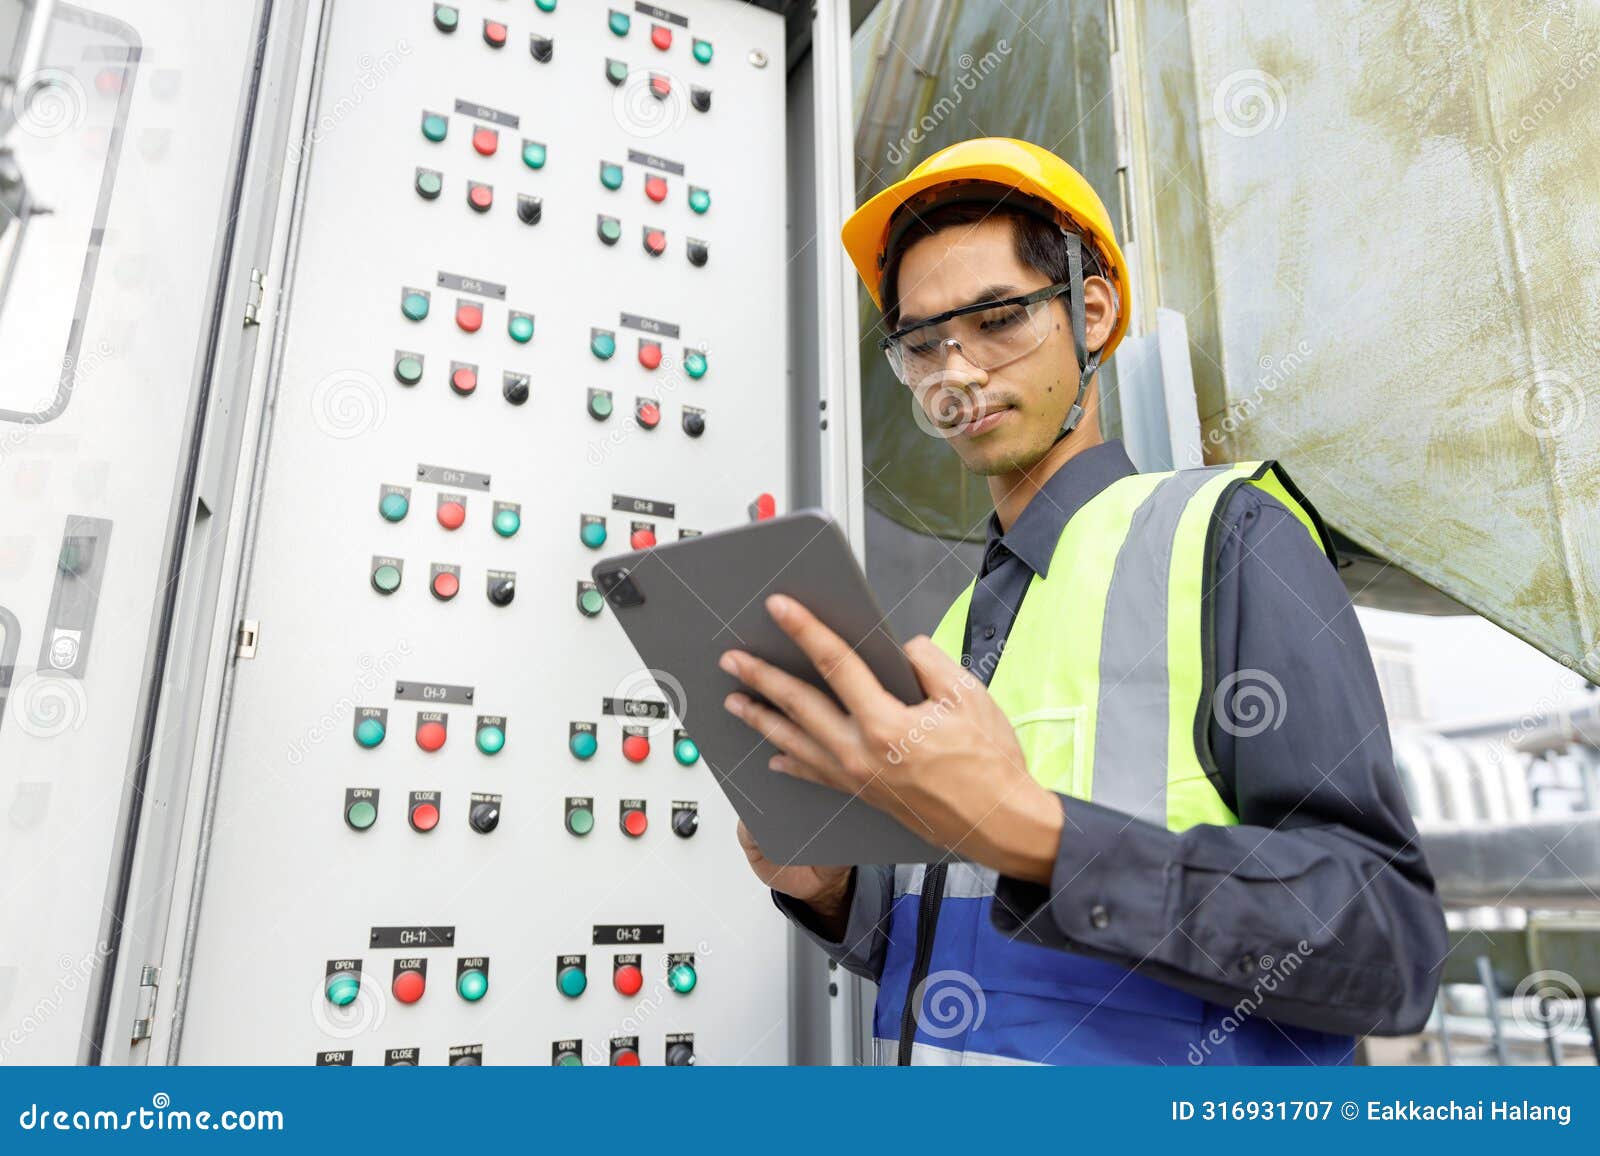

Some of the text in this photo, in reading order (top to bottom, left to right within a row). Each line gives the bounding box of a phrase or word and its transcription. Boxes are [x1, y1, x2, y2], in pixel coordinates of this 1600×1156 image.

[462, 278, 482, 292] CH-5
[443, 471, 465, 483] CH-7
[634, 500, 653, 512] CH-8
[424, 687, 446, 699] CH-9
[362, 709, 381, 717] OPEN
[483, 717, 501, 725] AUTO
[354, 789, 373, 797] OPEN
[415, 792, 435, 800] CLOSE
[400, 931, 427, 944] CH-11
[616, 928, 641, 941] CH-12
[400, 959, 422, 968] CLOSE
[464, 959, 482, 967] AUTO
[563, 956, 580, 965] OPEN
[335, 962, 354, 970] OPEN
[558, 1041, 576, 1050] OPEN
[325, 1052, 345, 1062] OPEN
[391, 1050, 413, 1059] CLOSE
